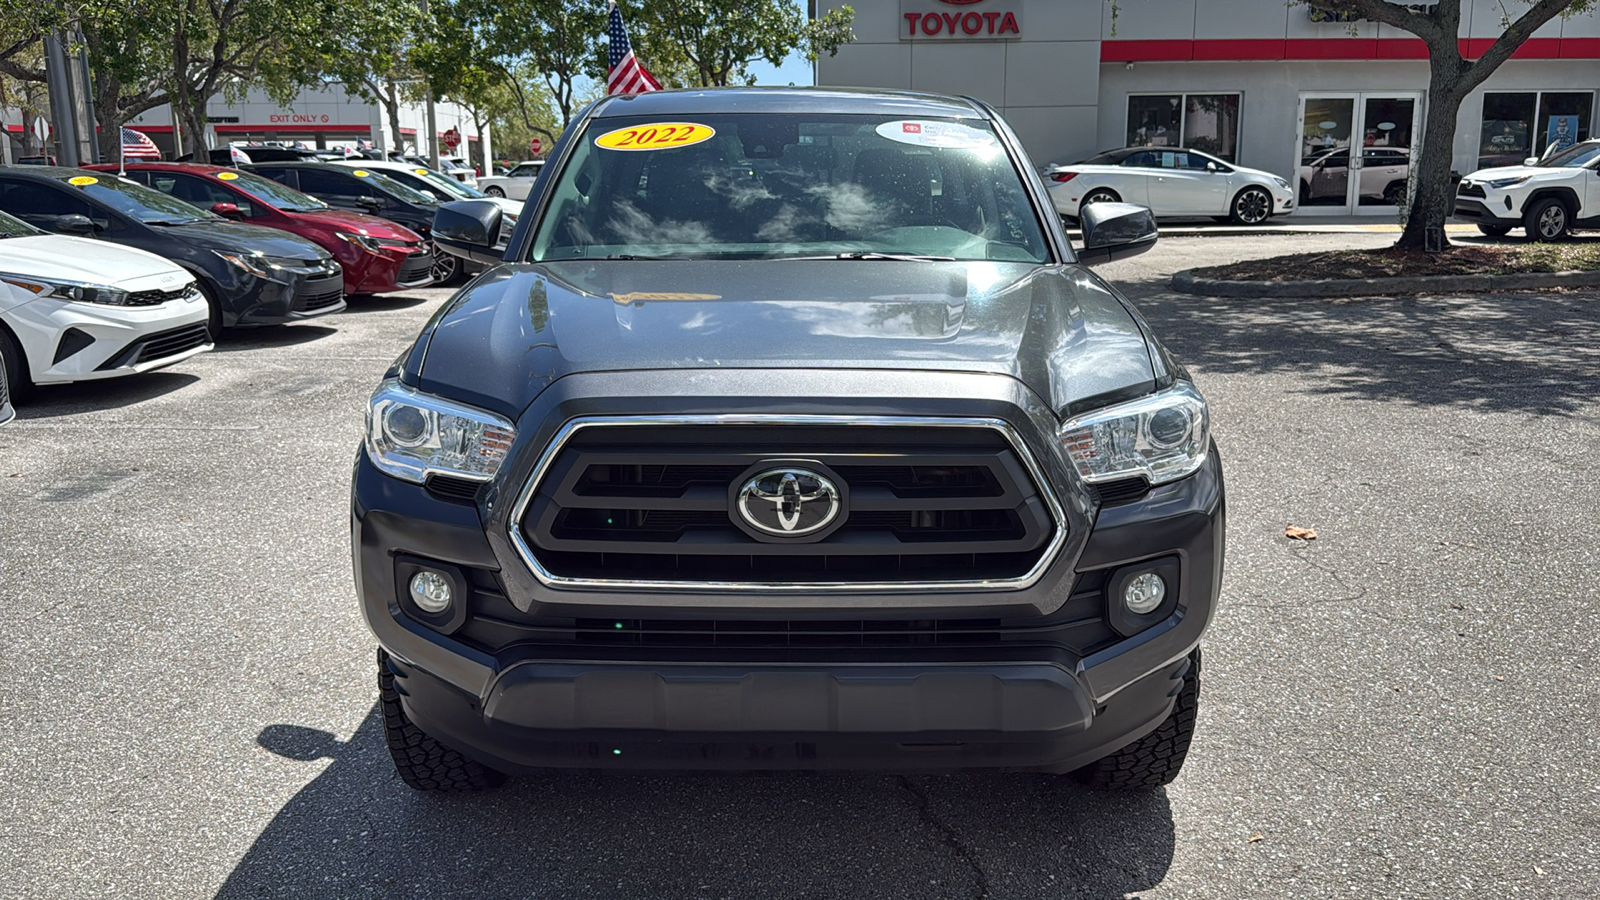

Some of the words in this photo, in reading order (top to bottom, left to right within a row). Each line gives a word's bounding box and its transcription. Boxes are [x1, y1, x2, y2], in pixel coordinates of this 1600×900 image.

[904, 12, 1020, 35] TOYOTA
[270, 114, 290, 122] EXIT
[293, 114, 317, 122] ONLY
[614, 126, 695, 147] 2022
